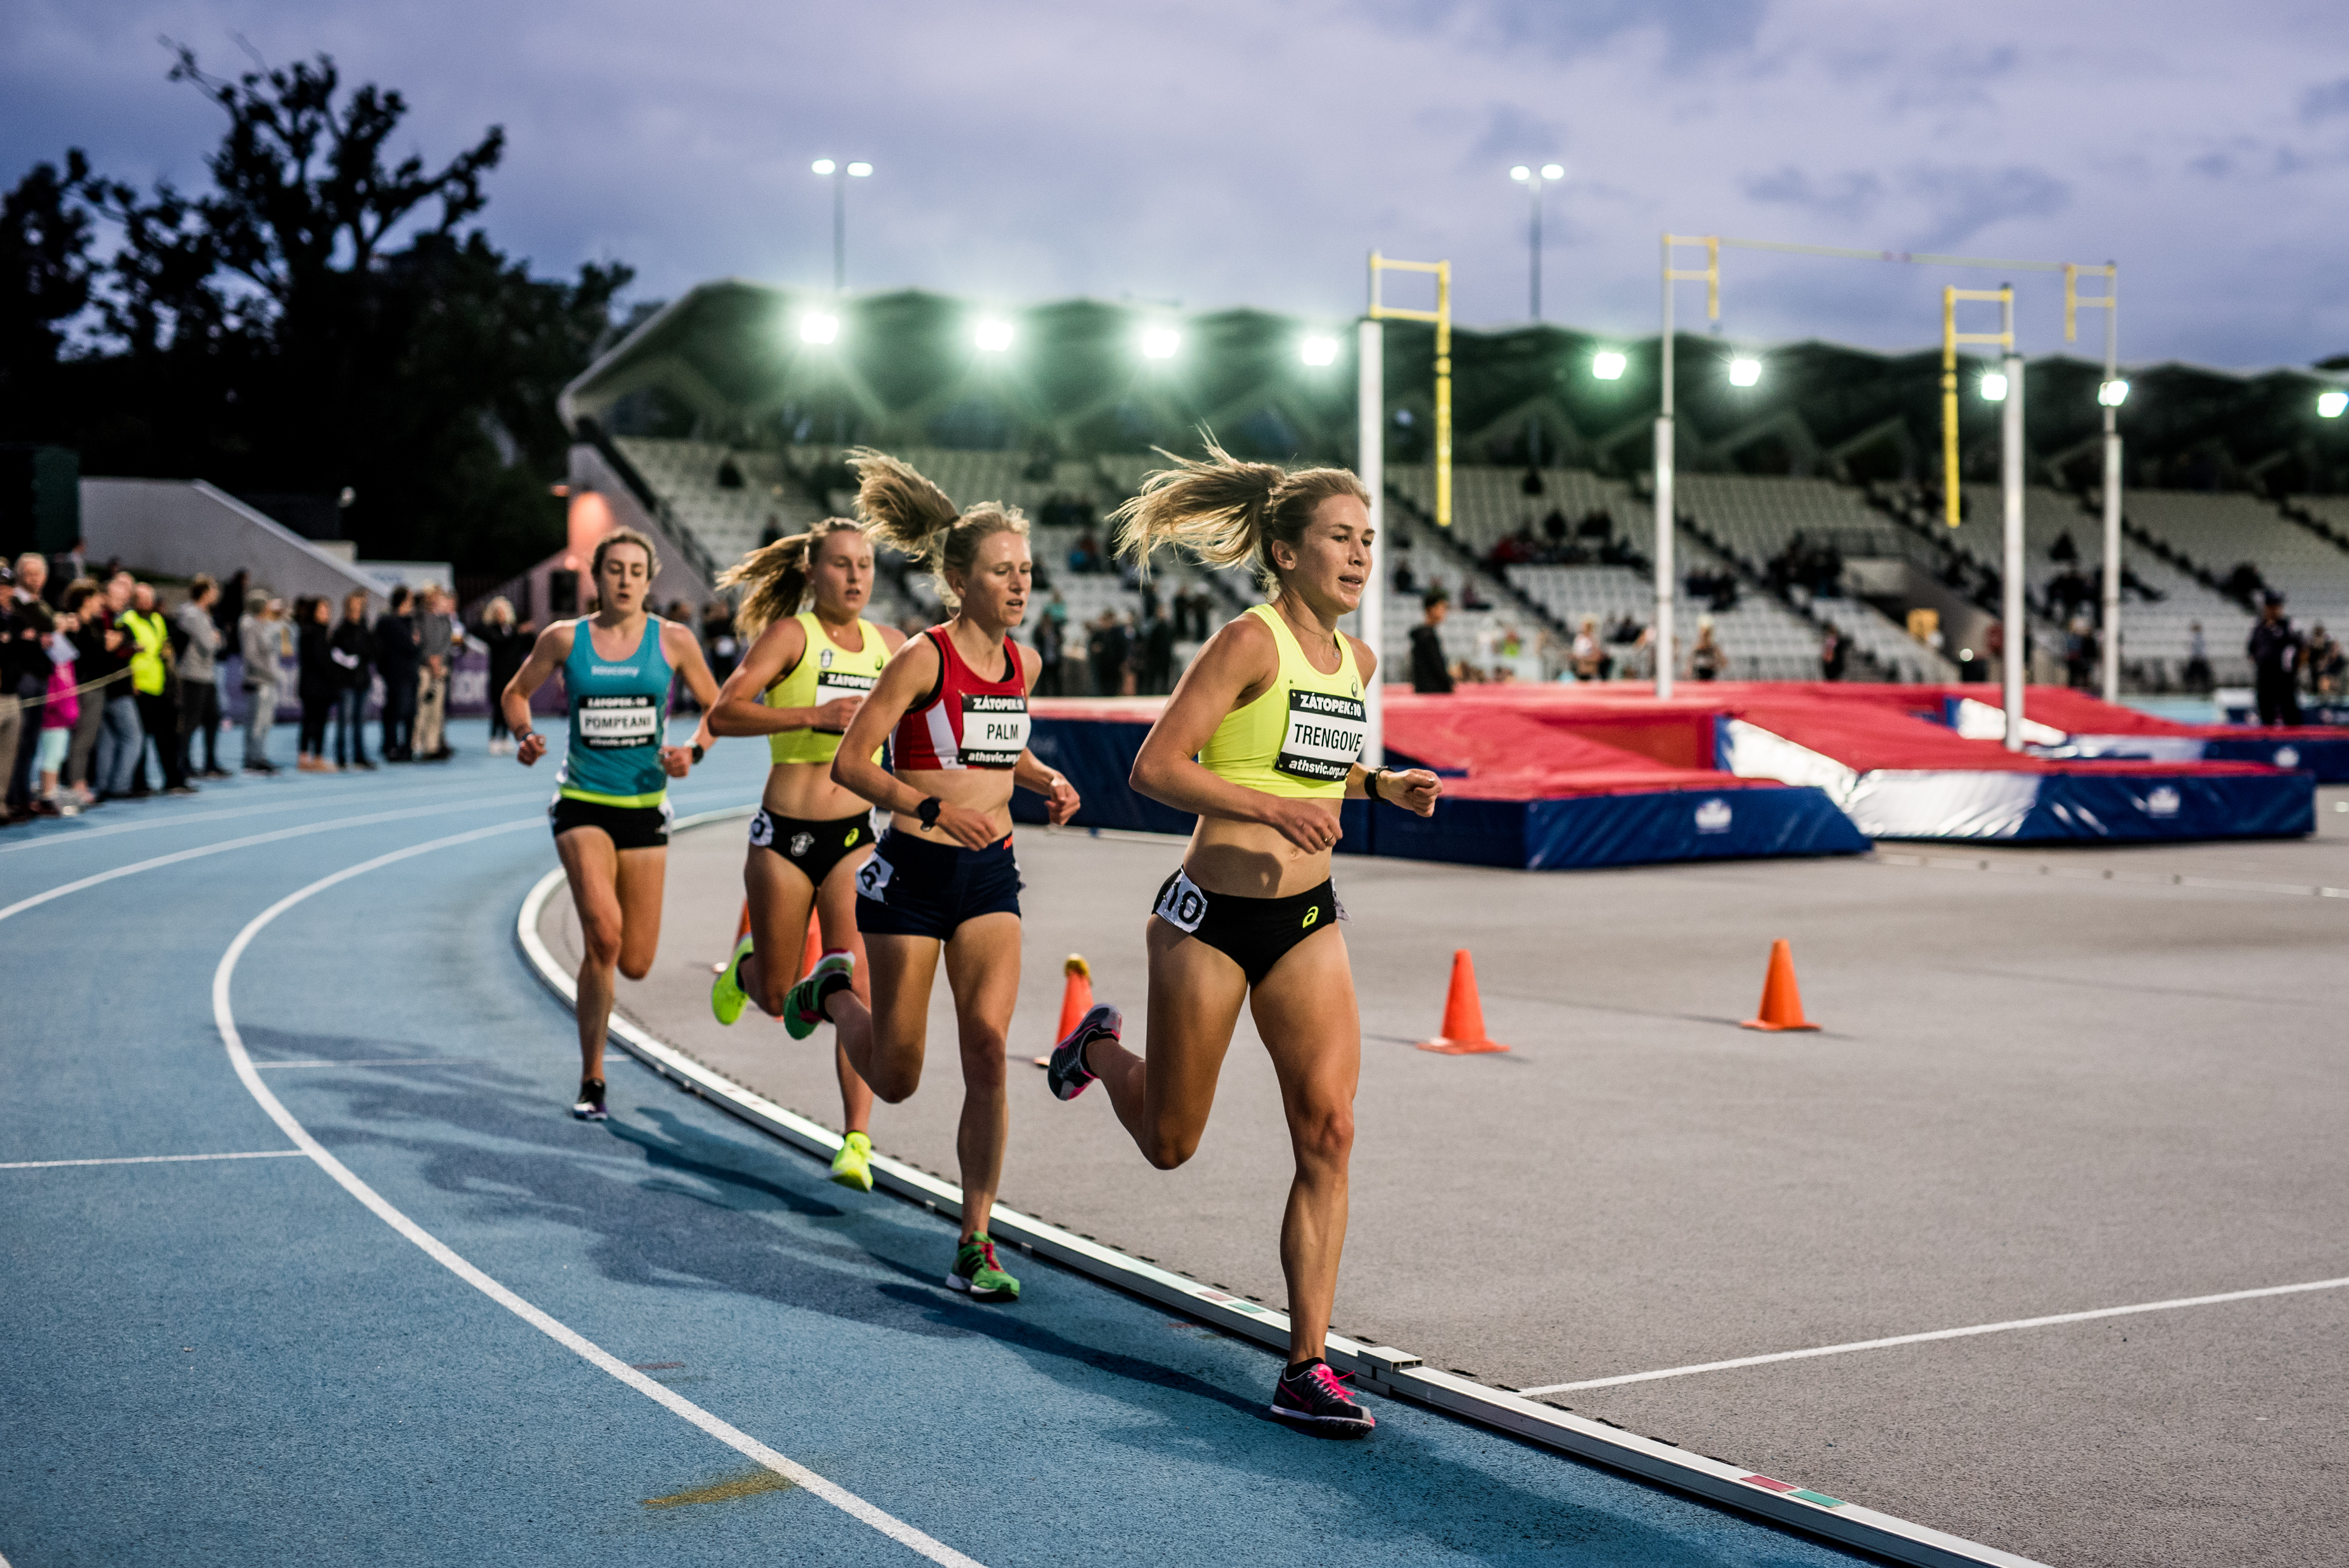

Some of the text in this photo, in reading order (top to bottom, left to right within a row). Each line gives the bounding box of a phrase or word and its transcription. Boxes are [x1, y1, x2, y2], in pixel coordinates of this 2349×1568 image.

[1300, 693, 1361, 717] ZÁTOPEK:10
[585, 717, 651, 729] POMPEANI
[987, 724, 1018, 740] PALM
[1295, 724, 1363, 752] TRENGOVE
[1168, 881, 1202, 924] 10
